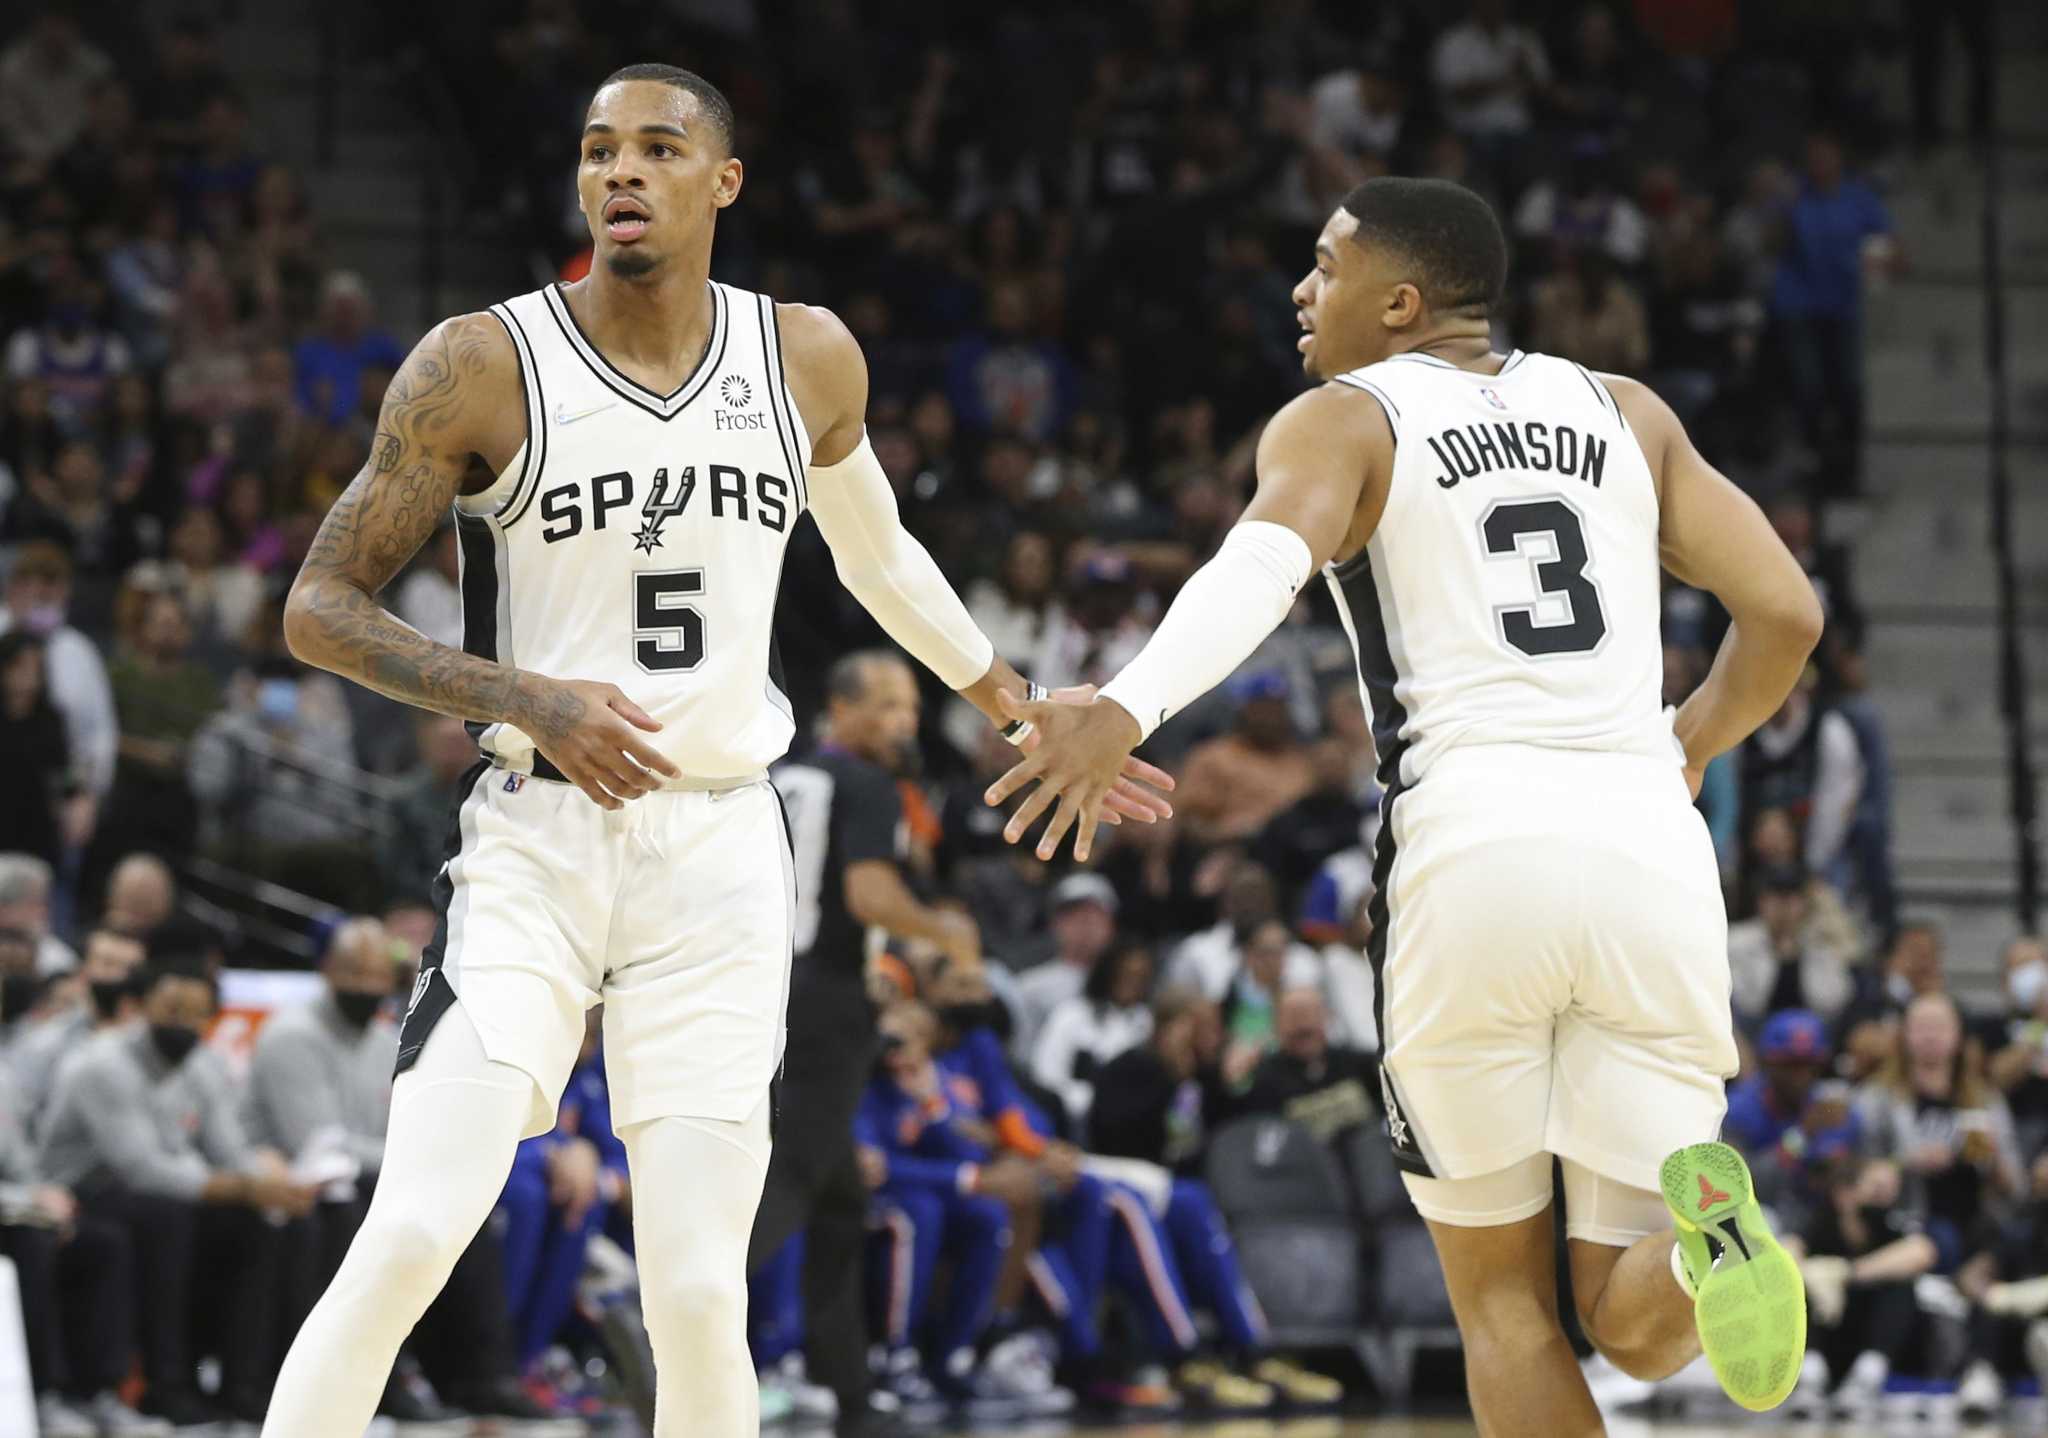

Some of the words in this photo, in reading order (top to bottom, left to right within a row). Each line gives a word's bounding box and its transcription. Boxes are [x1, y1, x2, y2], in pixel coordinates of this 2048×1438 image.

[715, 409, 767, 431] Frost
[1427, 422, 1607, 489] JOHNSON
[540, 464, 788, 556] SPURS
[632, 566, 708, 676] 5
[1475, 492, 1614, 664] 3
